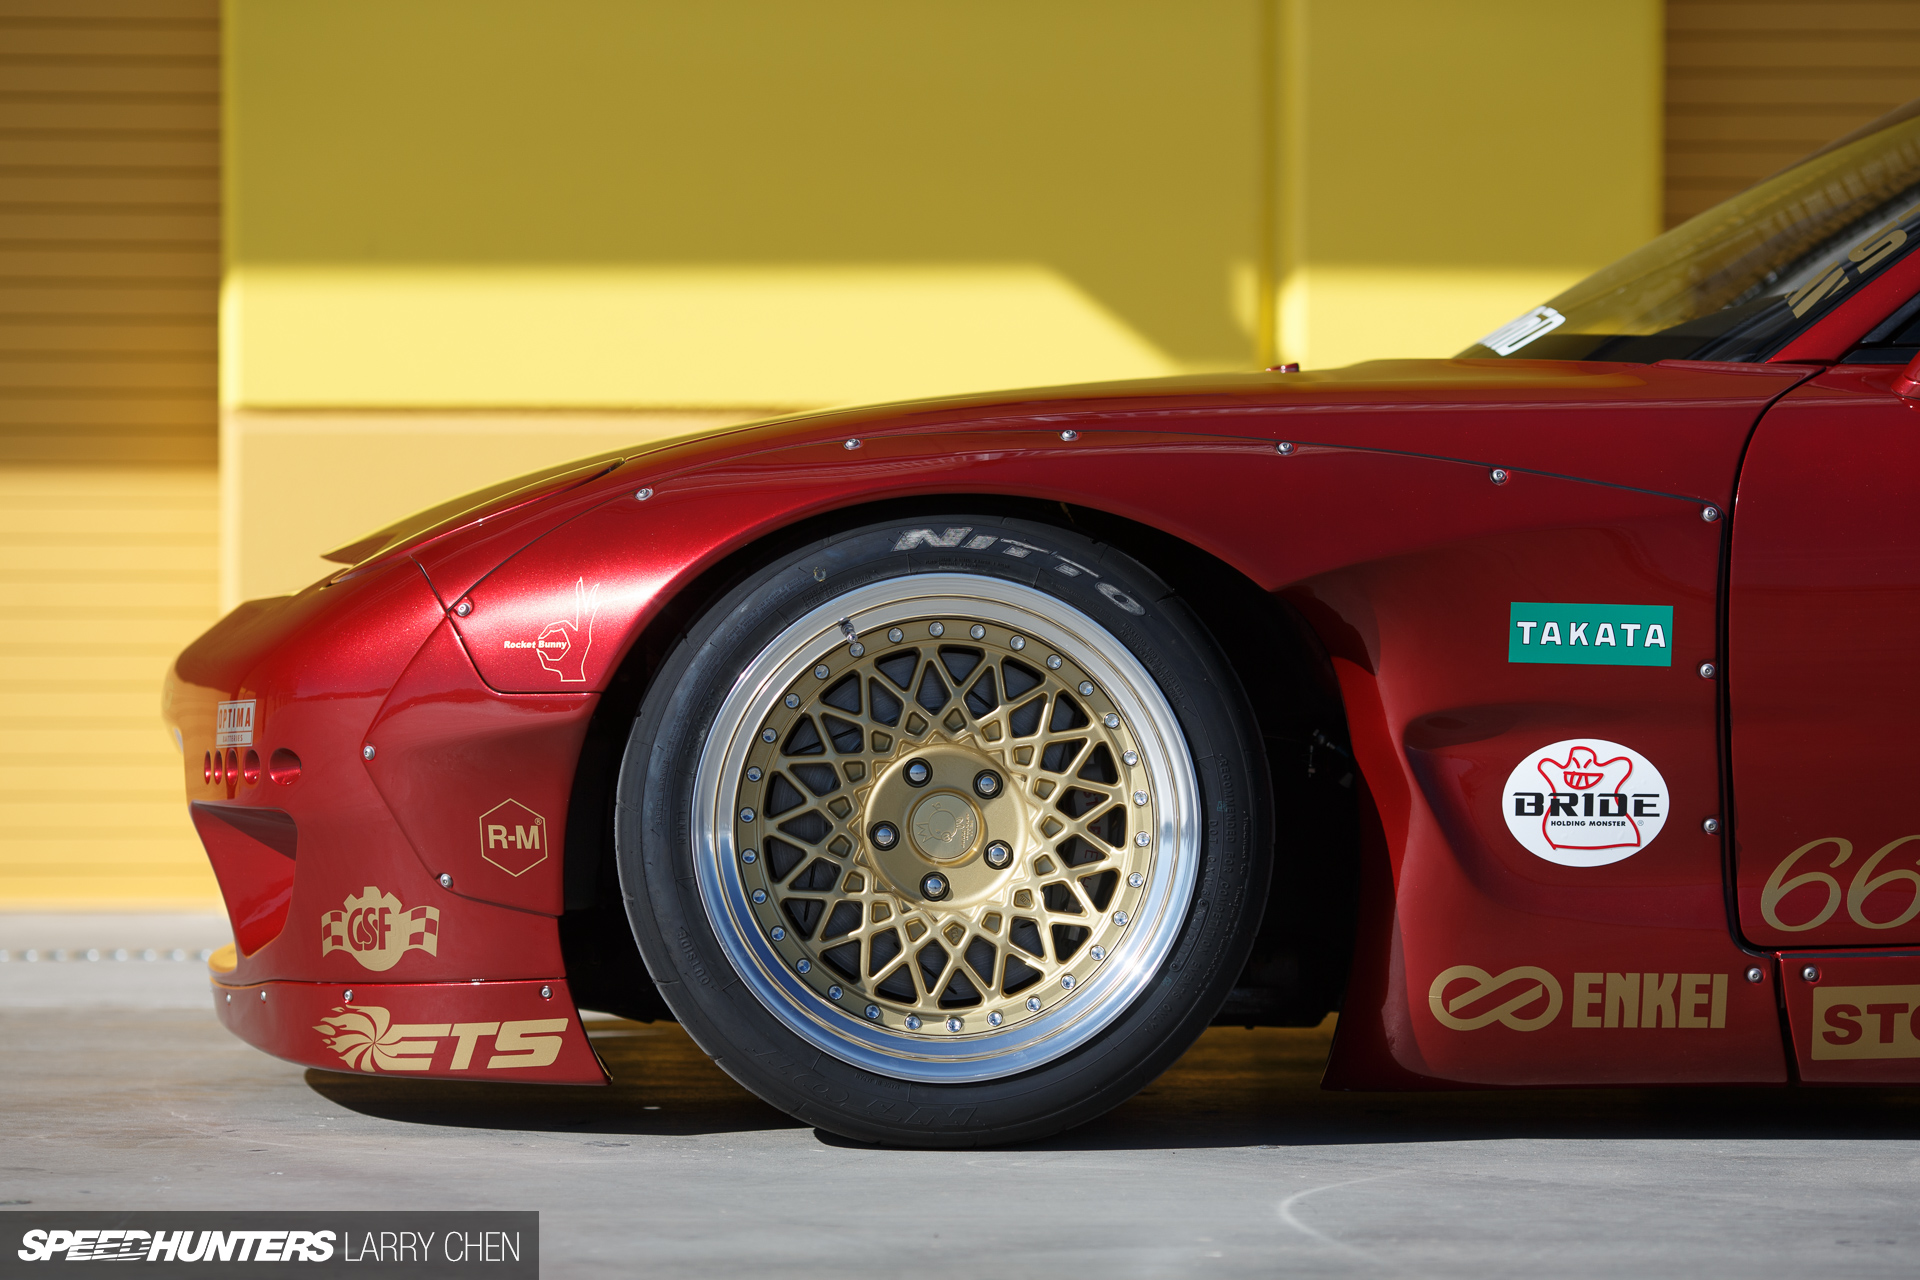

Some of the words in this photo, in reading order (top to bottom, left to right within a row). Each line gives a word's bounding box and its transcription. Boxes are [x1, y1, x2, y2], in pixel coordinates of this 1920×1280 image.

[891, 526, 1146, 617] NITTO
[504, 640, 537, 649] Rocket
[537, 640, 568, 650] Bunny
[1516, 620, 1667, 649] TAKATA
[218, 707, 251, 729] OPTIMA
[1217, 758, 1236, 843] RECOMMENDED
[1512, 791, 1661, 818] BRIDE
[1223, 850, 1235, 874] FOR
[347, 906, 392, 952] CSF
[675, 929, 711, 987] OUTSIDE
[1571, 972, 1729, 1029] ENKEI
[352, 1015, 569, 1072] ETS
